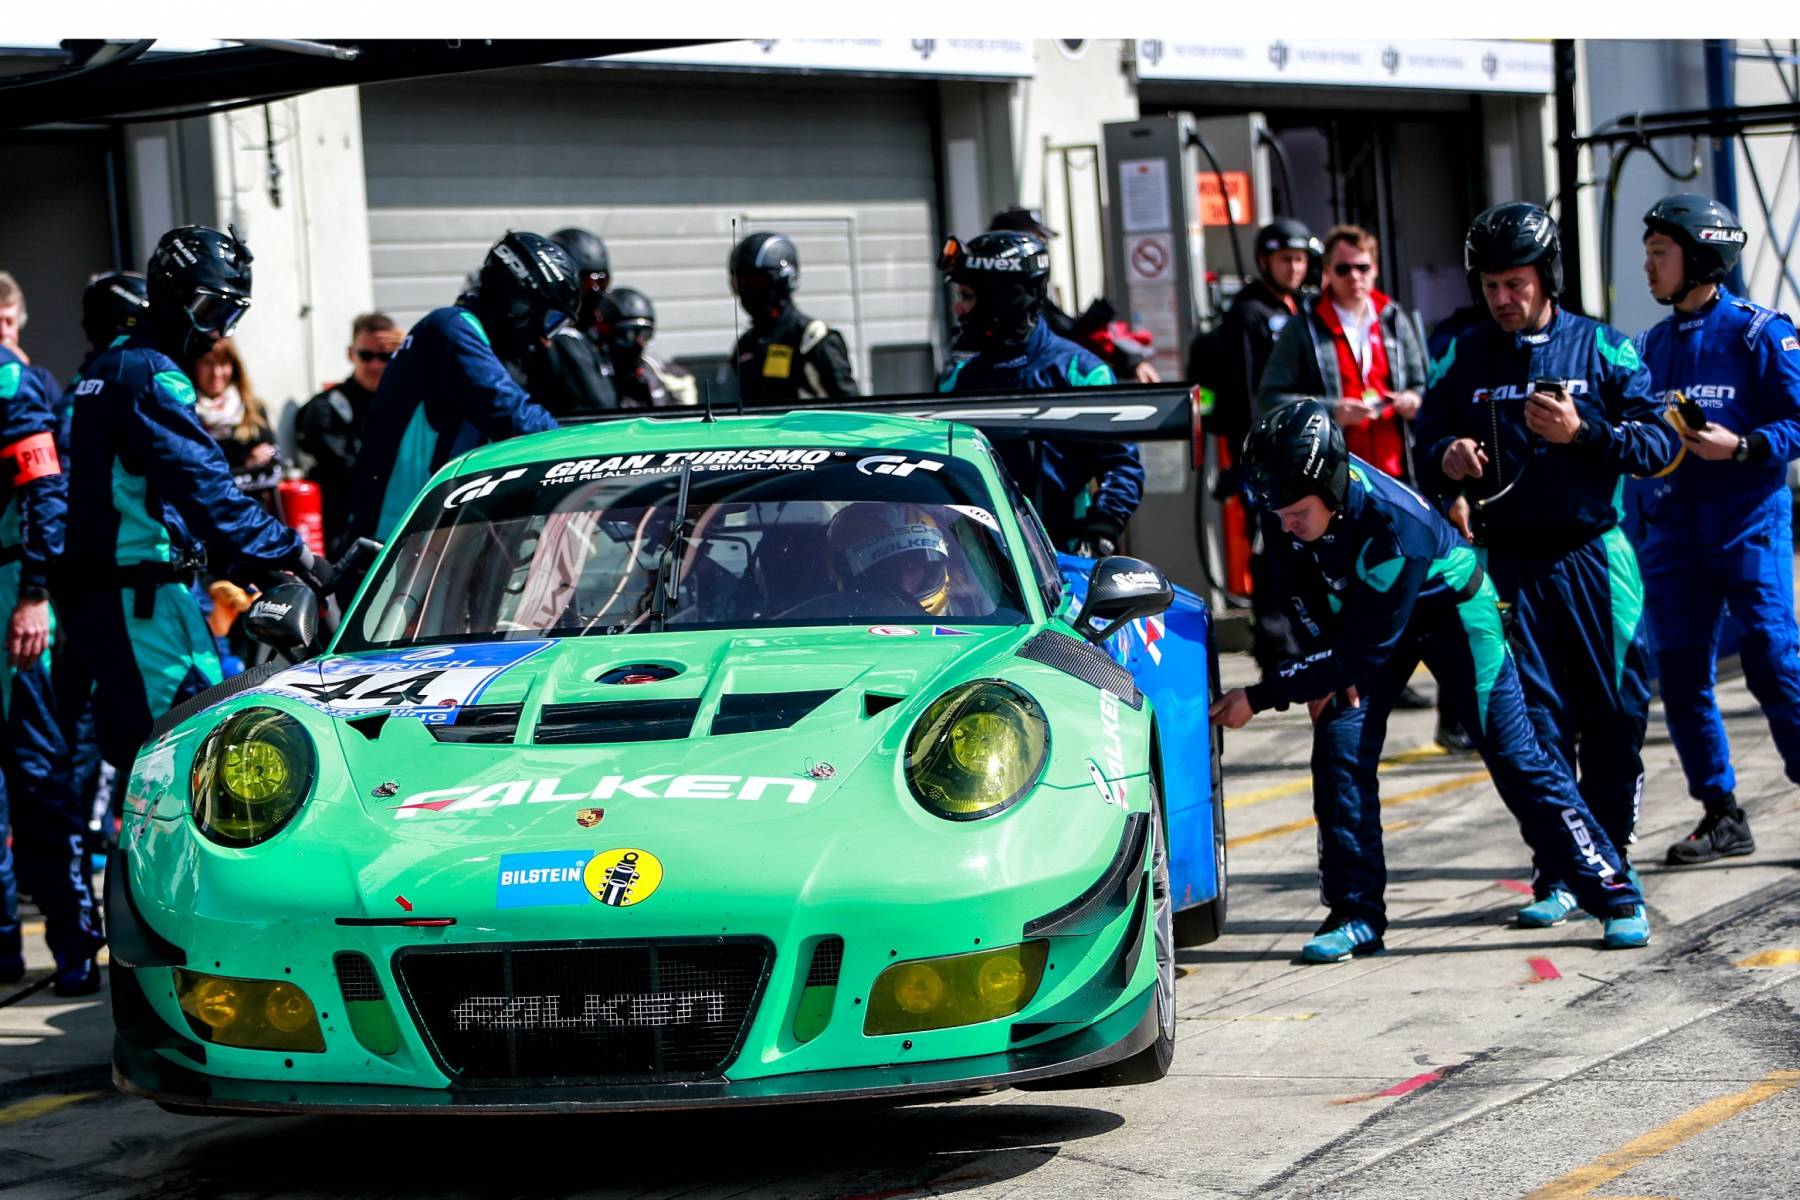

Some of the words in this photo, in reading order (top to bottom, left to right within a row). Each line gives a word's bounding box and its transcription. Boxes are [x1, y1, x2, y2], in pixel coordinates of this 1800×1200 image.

[965, 256, 1022, 271] uvex
[1472, 379, 1589, 403] FALN
[540, 477, 574, 486] THE
[579, 471, 625, 480] REAL
[709, 463, 816, 471] SIMULATOR
[545, 454, 655, 478] GRAN
[661, 449, 831, 467] TURISMO
[287, 670, 448, 706] 44
[388, 775, 818, 819] FALKEN
[1561, 808, 1620, 889] LKEN
[501, 867, 581, 886] BILSTEIN
[451, 992, 725, 1031] FALKEN
